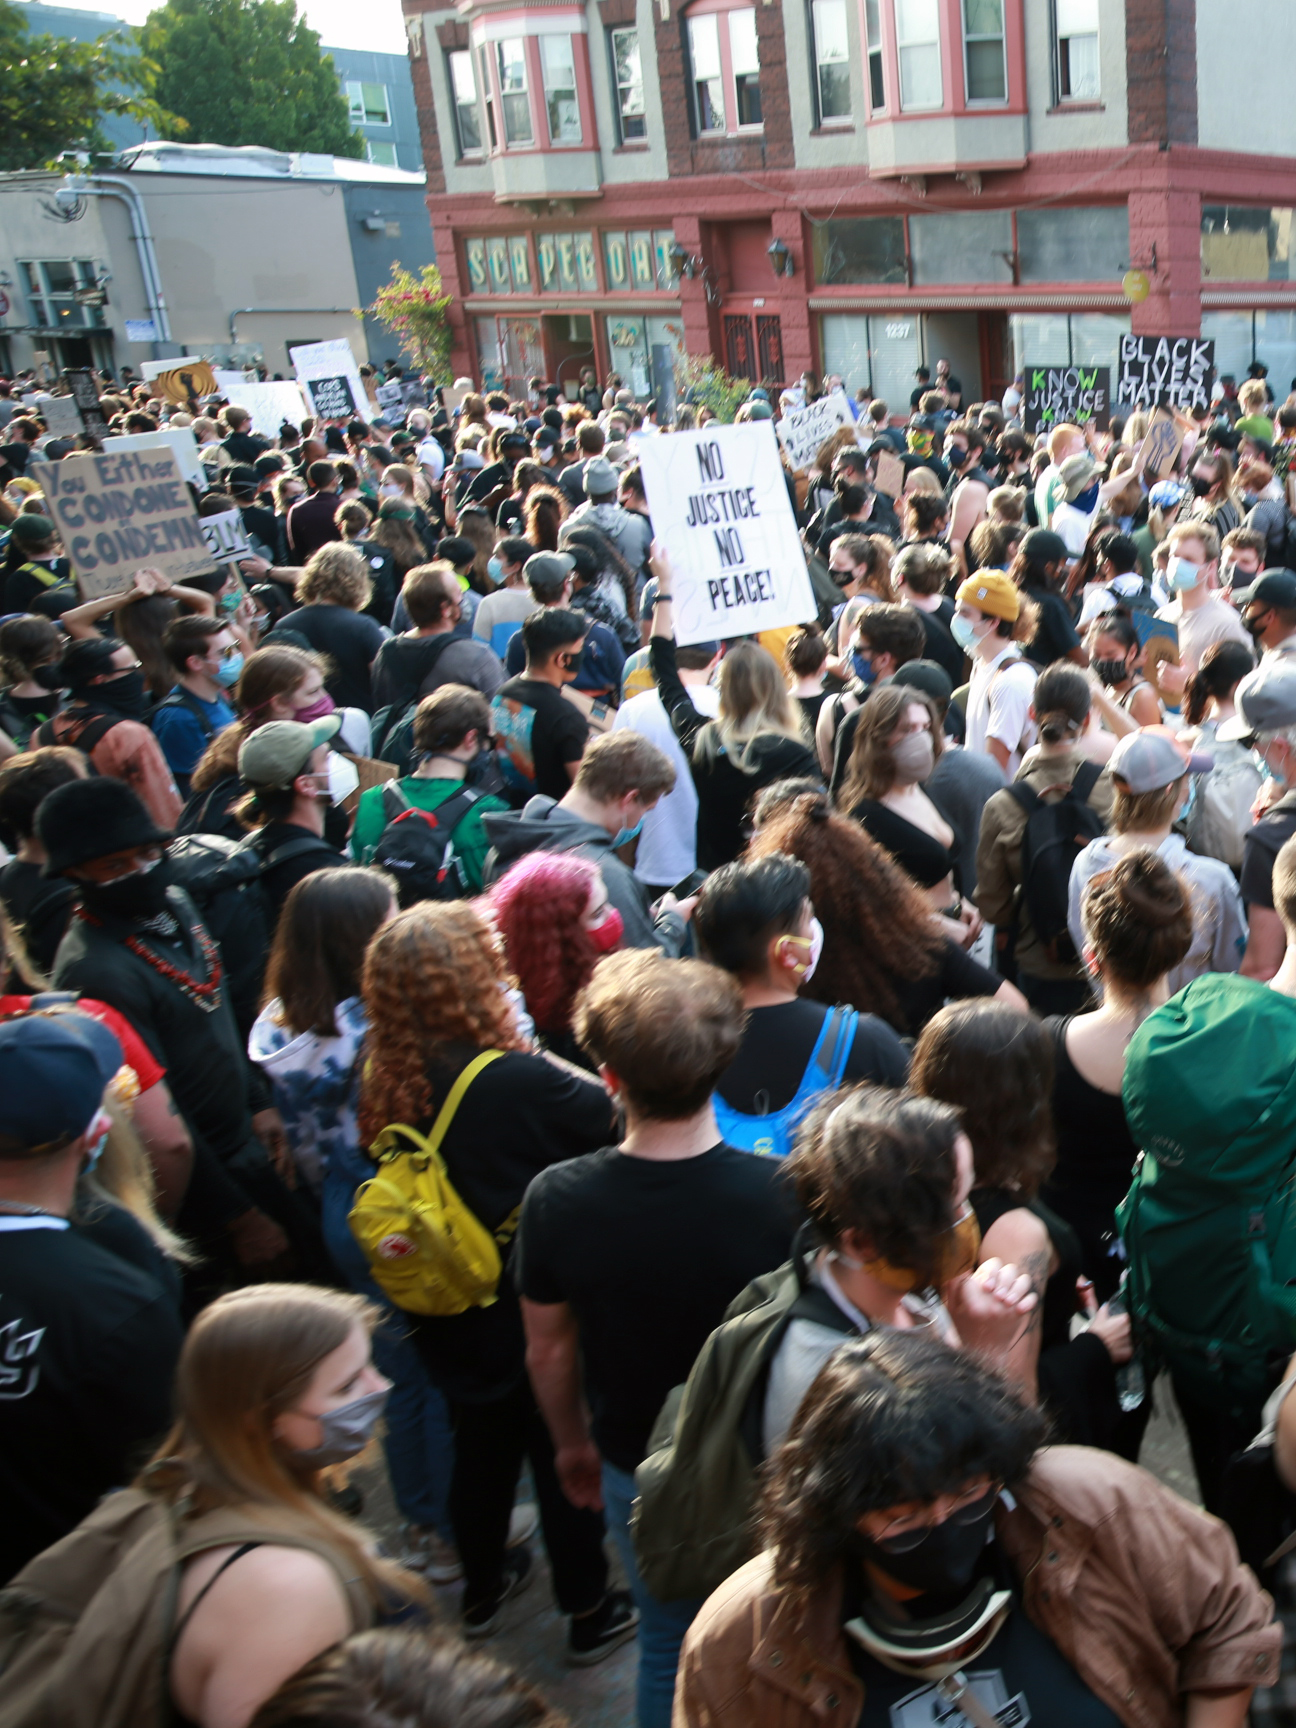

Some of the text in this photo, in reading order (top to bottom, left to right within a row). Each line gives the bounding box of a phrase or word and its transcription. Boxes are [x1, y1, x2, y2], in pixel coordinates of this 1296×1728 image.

[1122, 334, 1211, 371] BLACK
[1032, 367, 1098, 392] KNOW
[1118, 379, 1208, 411] MATTER
[1124, 360, 1204, 391] LIVES
[1029, 389, 1105, 411] JUSTICE
[39, 451, 174, 497] You Either
[695, 442, 724, 483] NO
[57, 481, 189, 529] CONDONE
[686, 487, 760, 526] JUSTICE
[71, 514, 207, 570] CONDEMN
[713, 527, 745, 567] NO
[708, 569, 776, 610] PEACE!
